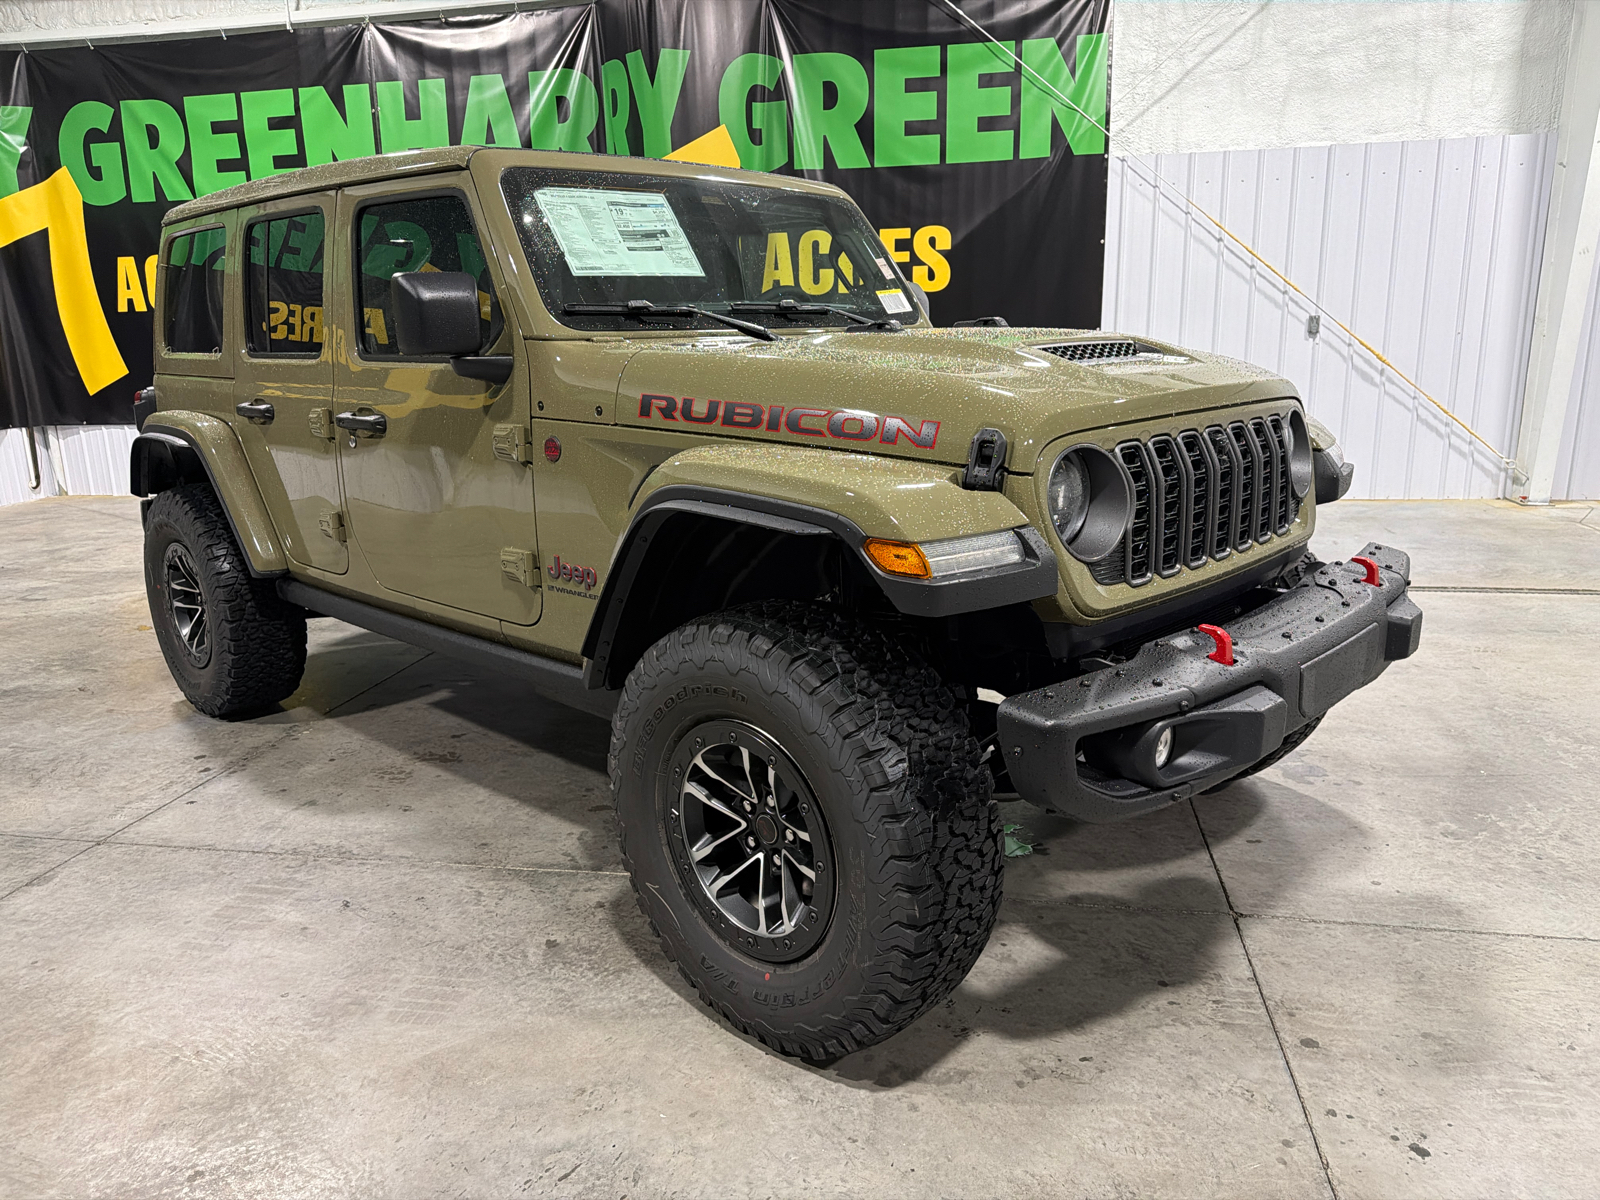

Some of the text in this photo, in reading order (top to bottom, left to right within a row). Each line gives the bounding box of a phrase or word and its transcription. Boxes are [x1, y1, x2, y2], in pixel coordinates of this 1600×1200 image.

[718, 33, 1109, 172] GREEN
[58, 84, 376, 206] GREEN
[637, 393, 941, 450] RUBICON
[547, 554, 598, 591] Jeep
[554, 585, 600, 601] WRANGLER
[632, 682, 748, 779] BFGoodrich
